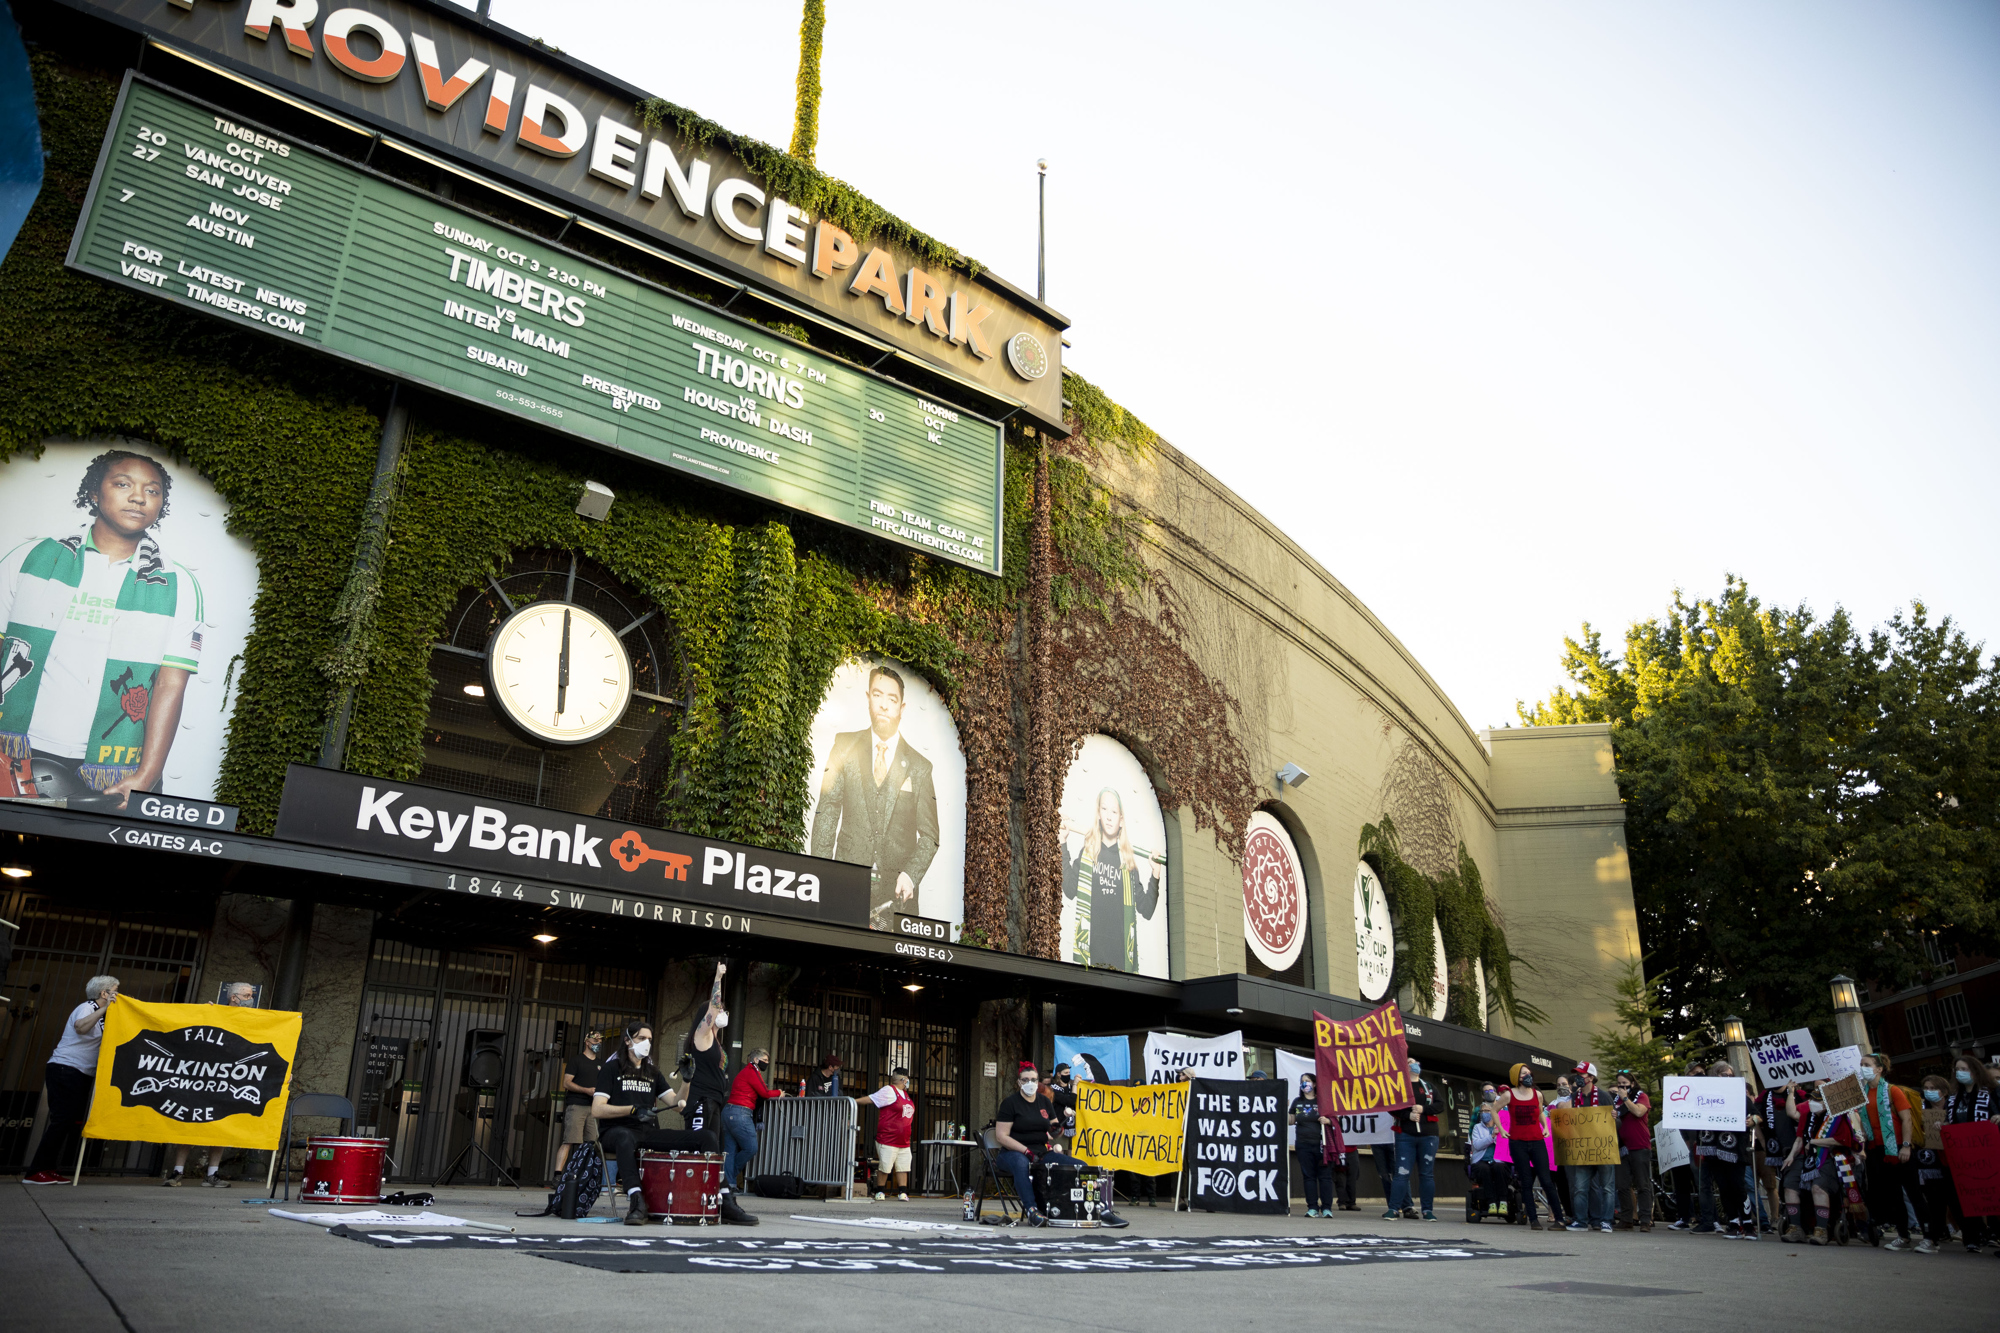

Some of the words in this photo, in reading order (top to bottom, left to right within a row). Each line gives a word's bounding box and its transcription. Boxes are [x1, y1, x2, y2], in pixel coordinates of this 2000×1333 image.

[214, 116, 291, 157] TIMBERS
[137, 126, 167, 146] 20
[184, 143, 291, 196] VANCOUVER
[226, 142, 263, 165] OCT
[132, 145, 161, 162] 27
[185, 164, 225, 189] SAN
[233, 184, 283, 211] JOSE
[164, 0, 809, 267] ROVIDENCE
[812, 219, 994, 361] PARK
[119, 189, 135, 203] 7
[186, 214, 254, 249] AUSTIN
[208, 202, 250, 225] NOV
[433, 221, 494, 253] SUNDAY
[496, 246, 527, 267] OCT
[529, 259, 540, 272] 3
[582, 280, 606, 299] PM
[122, 241, 163, 266] FOR
[177, 260, 246, 294] LATEST
[255, 287, 307, 316] NEWS
[445, 247, 587, 327] TIMBERS
[120, 260, 168, 287] VISIT
[186, 283, 306, 335] TIMBERS.COM
[495, 306, 516, 323] VS
[443, 300, 501, 334] INTER
[511, 328, 570, 359] MIAMI
[467, 346, 529, 377] SUBARU
[671, 313, 748, 353] WEDNESDAY
[752, 346, 778, 366] OCT
[780, 356, 789, 369] 6
[796, 363, 805, 374] 7
[807, 368, 827, 385] PM
[692, 342, 805, 410] THORNS
[496, 389, 563, 418] 503-553-5555
[582, 374, 662, 411] PRESENTED
[612, 397, 634, 413] BY
[738, 395, 757, 411] VS
[684, 387, 761, 428] HOUSTON
[769, 418, 813, 446] DASH
[869, 408, 886, 423] 30
[924, 415, 946, 433] OCT
[917, 397, 959, 424] THORNS
[700, 427, 780, 465] PROVIDENCE
[927, 431, 942, 446] NC
[672, 452, 730, 475] PORTLANDTIMBERS.COM
[870, 500, 896, 518] FIND
[901, 510, 932, 531] TEAM
[937, 524, 966, 544] GEAR
[971, 537, 985, 549] AT
[871, 516, 984, 564] PTFCAUTHENTICS.COM
[140, 798, 200, 822] Gate
[206, 807, 225, 826] D
[125, 830, 186, 850] GATES
[189, 839, 223, 855] A-C
[356, 786, 603, 868] KeyBank
[702, 846, 821, 903] Plaza
[1092, 861, 1121, 880] WOMEN
[1246, 836, 1295, 884] PORTLAND
[1100, 876, 1116, 887] BALL
[447, 874, 524, 900] 1844
[550, 889, 585, 910] SW
[611, 899, 750, 932] MORRISON
[900, 918, 932, 936] Gate
[935, 923, 945, 938] D
[1249, 900, 1297, 945] THORNS
[895, 942, 926, 957] GATES
[928, 948, 946, 960] E-G
[1373, 940, 1387, 958] CUP
[184, 1028, 225, 1046] FALL
[1315, 1005, 1403, 1047] BELIEVE
[1405, 1023, 1422, 1037] Tickets
[138, 1054, 267, 1081] WILKINSON
[1213, 1051, 1238, 1067] UP
[1335, 1043, 1398, 1078] NADIA
[1757, 1044, 1803, 1065] SHAME
[1768, 1065, 1789, 1080] ON
[1787, 1060, 1815, 1077] YOU
[168, 1076, 230, 1093] SWORD
[1331, 1071, 1408, 1112] NADIM
[1826, 1075, 1853, 1095] STOP
[159, 1099, 214, 1122] HERE
[1078, 1088, 1123, 1114] HOLD
[1197, 1093, 1231, 1112] THE
[1238, 1095, 1277, 1113] BAR
[1198, 1118, 1241, 1138] WAS
[1251, 1120, 1276, 1138] SO
[1075, 1128, 1183, 1164] ACCOUNTABLE
[1197, 1142, 1237, 1162] LOW
[1243, 1144, 1278, 1163] BUT
[1557, 1137, 1592, 1148] PROTECT
[1593, 1135, 1614, 1149] OUR
[1565, 1148, 1611, 1162] PLAYERS!
